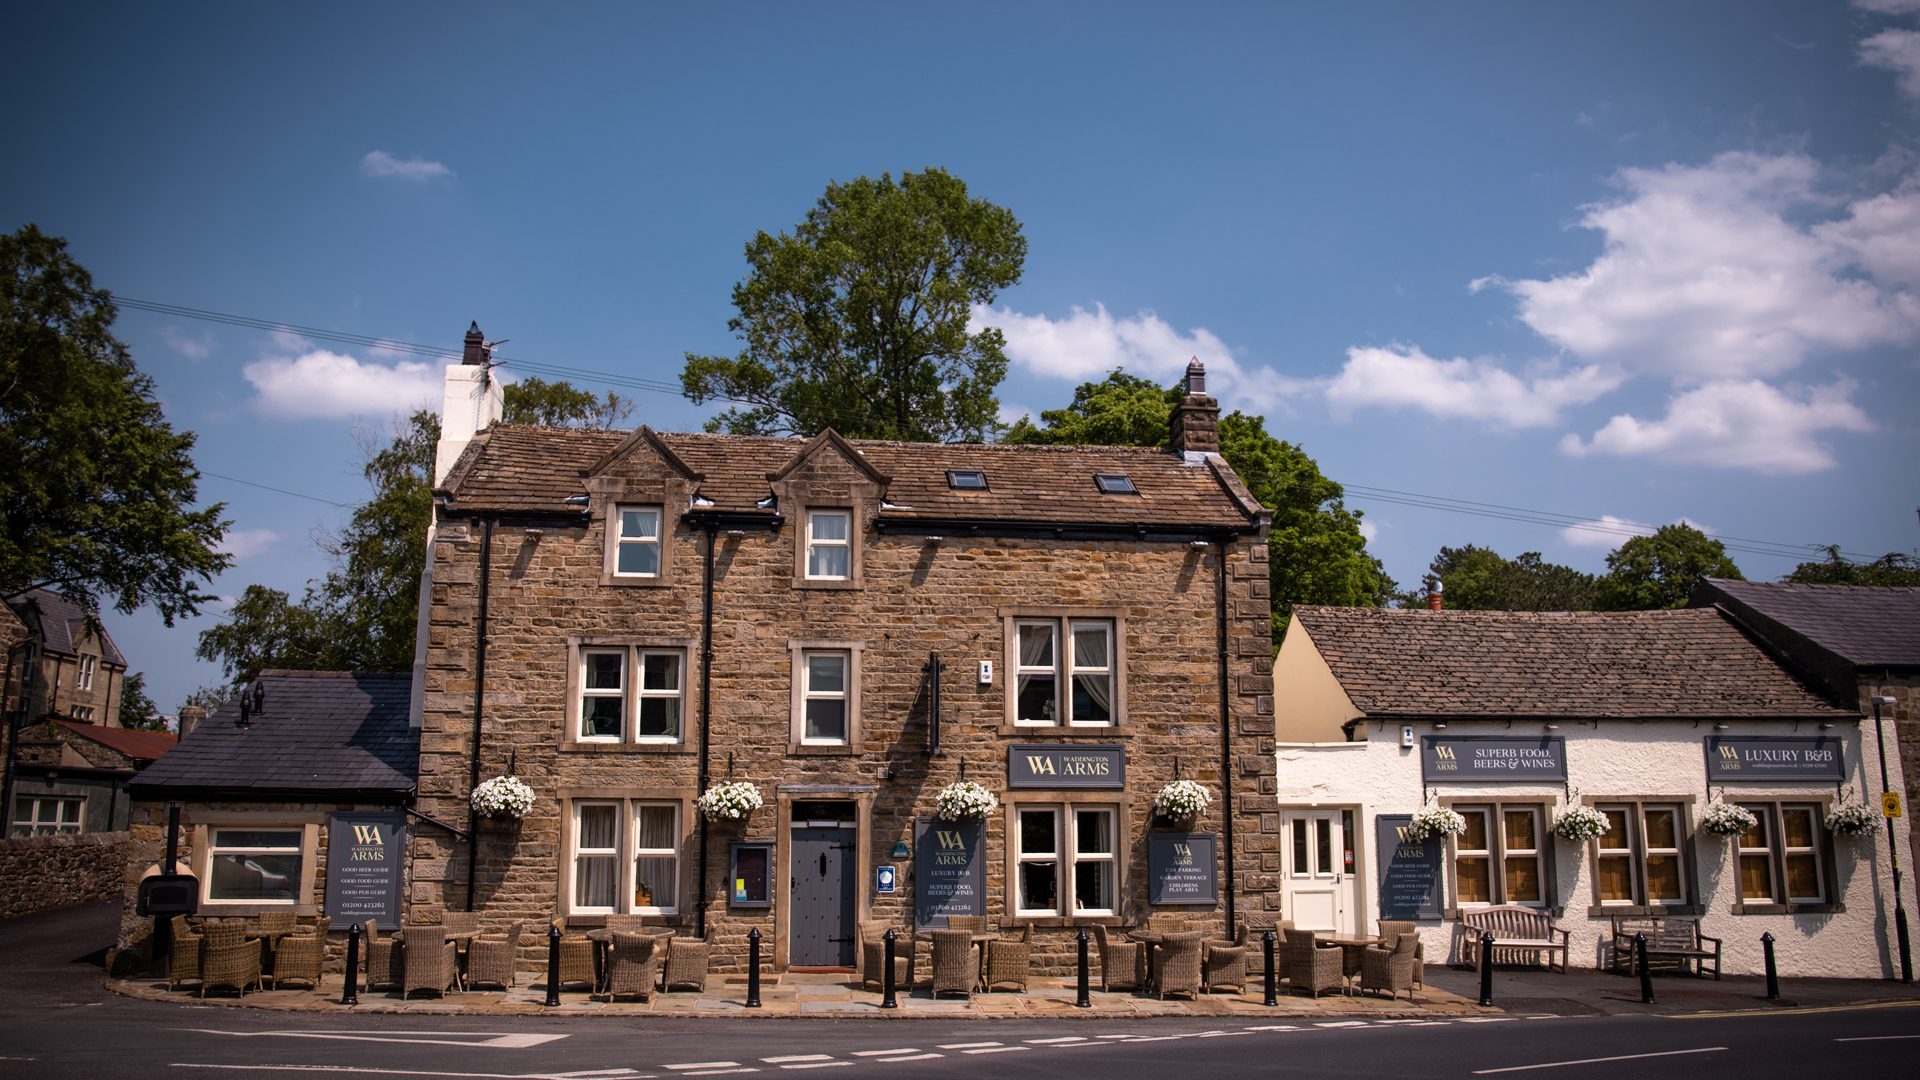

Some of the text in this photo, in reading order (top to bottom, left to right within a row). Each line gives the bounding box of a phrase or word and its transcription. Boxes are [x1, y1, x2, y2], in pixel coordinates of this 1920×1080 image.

[1435, 746, 1456, 760] WA
[1475, 748, 1517, 758] SUPERB
[1719, 746, 1738, 759] WA
[1745, 749, 1833, 762] LUXURY B&B
[1025, 755, 1057, 775] WA
[1063, 762, 1110, 776] ARMS
[1436, 763, 1458, 771] ARMS
[1474, 758, 1555, 769] BEERS & WINES
[1720, 763, 1741, 771] ARMS
[352, 825, 384, 845] WA
[935, 830, 967, 850] WA
[350, 851, 385, 861] ARMS
[1173, 843, 1192, 856] WA
[1396, 849, 1425, 859] ARMS
[935, 855, 967, 865] ARMS
